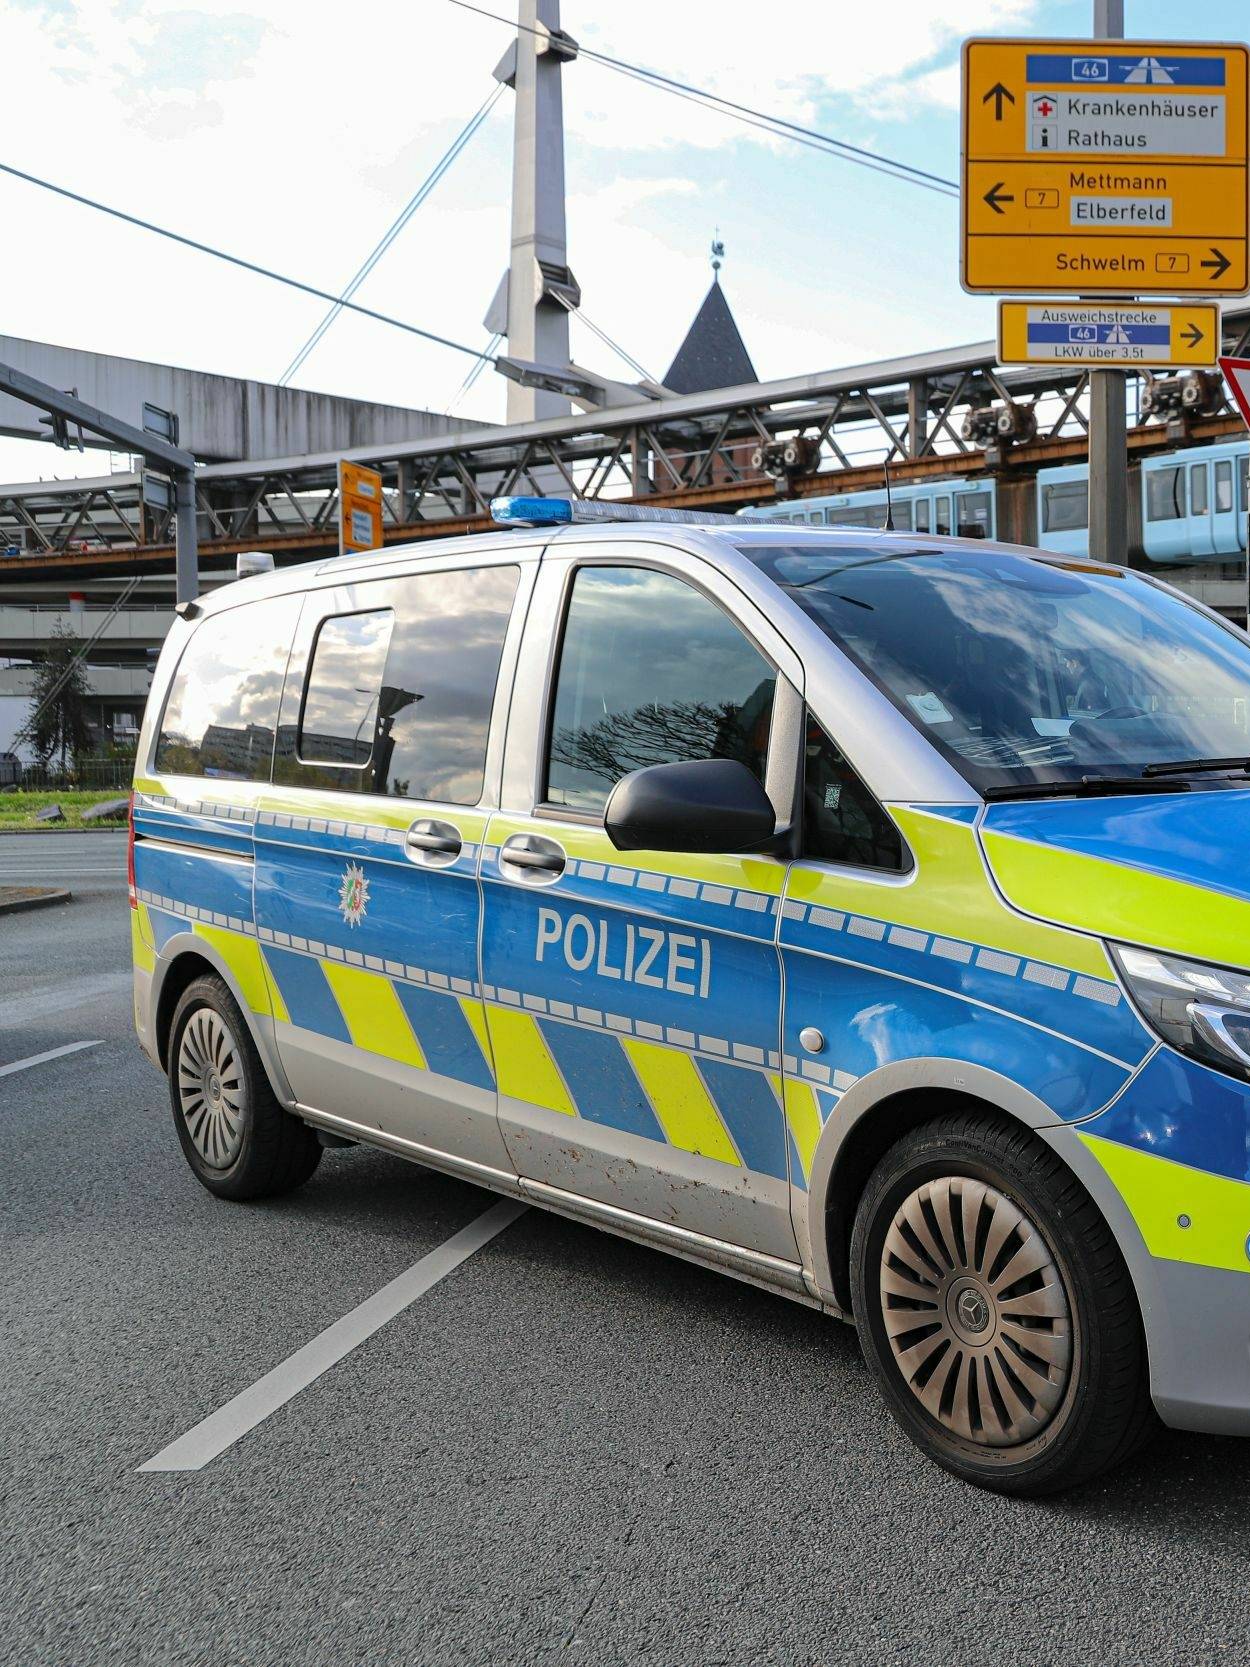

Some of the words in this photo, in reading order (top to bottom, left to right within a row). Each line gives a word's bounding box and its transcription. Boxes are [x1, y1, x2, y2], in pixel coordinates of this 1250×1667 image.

[1081, 63, 1099, 77] 46
[1068, 99, 1219, 118] Krankenhäuser
[1068, 129, 1148, 147] Rathaus
[1070, 173, 1167, 190] Mettmann
[1038, 192, 1046, 205] 7
[1076, 202, 1166, 221] Elberfeld
[1056, 253, 1145, 271] Schwelm
[1168, 257, 1176, 270] 7
[1041, 310, 1157, 324] Ausweichstrecke
[1076, 328, 1090, 339] 46
[1054, 346, 1083, 358] LKW
[1089, 347, 1116, 358] über
[535, 907, 711, 999] POLIZEI
